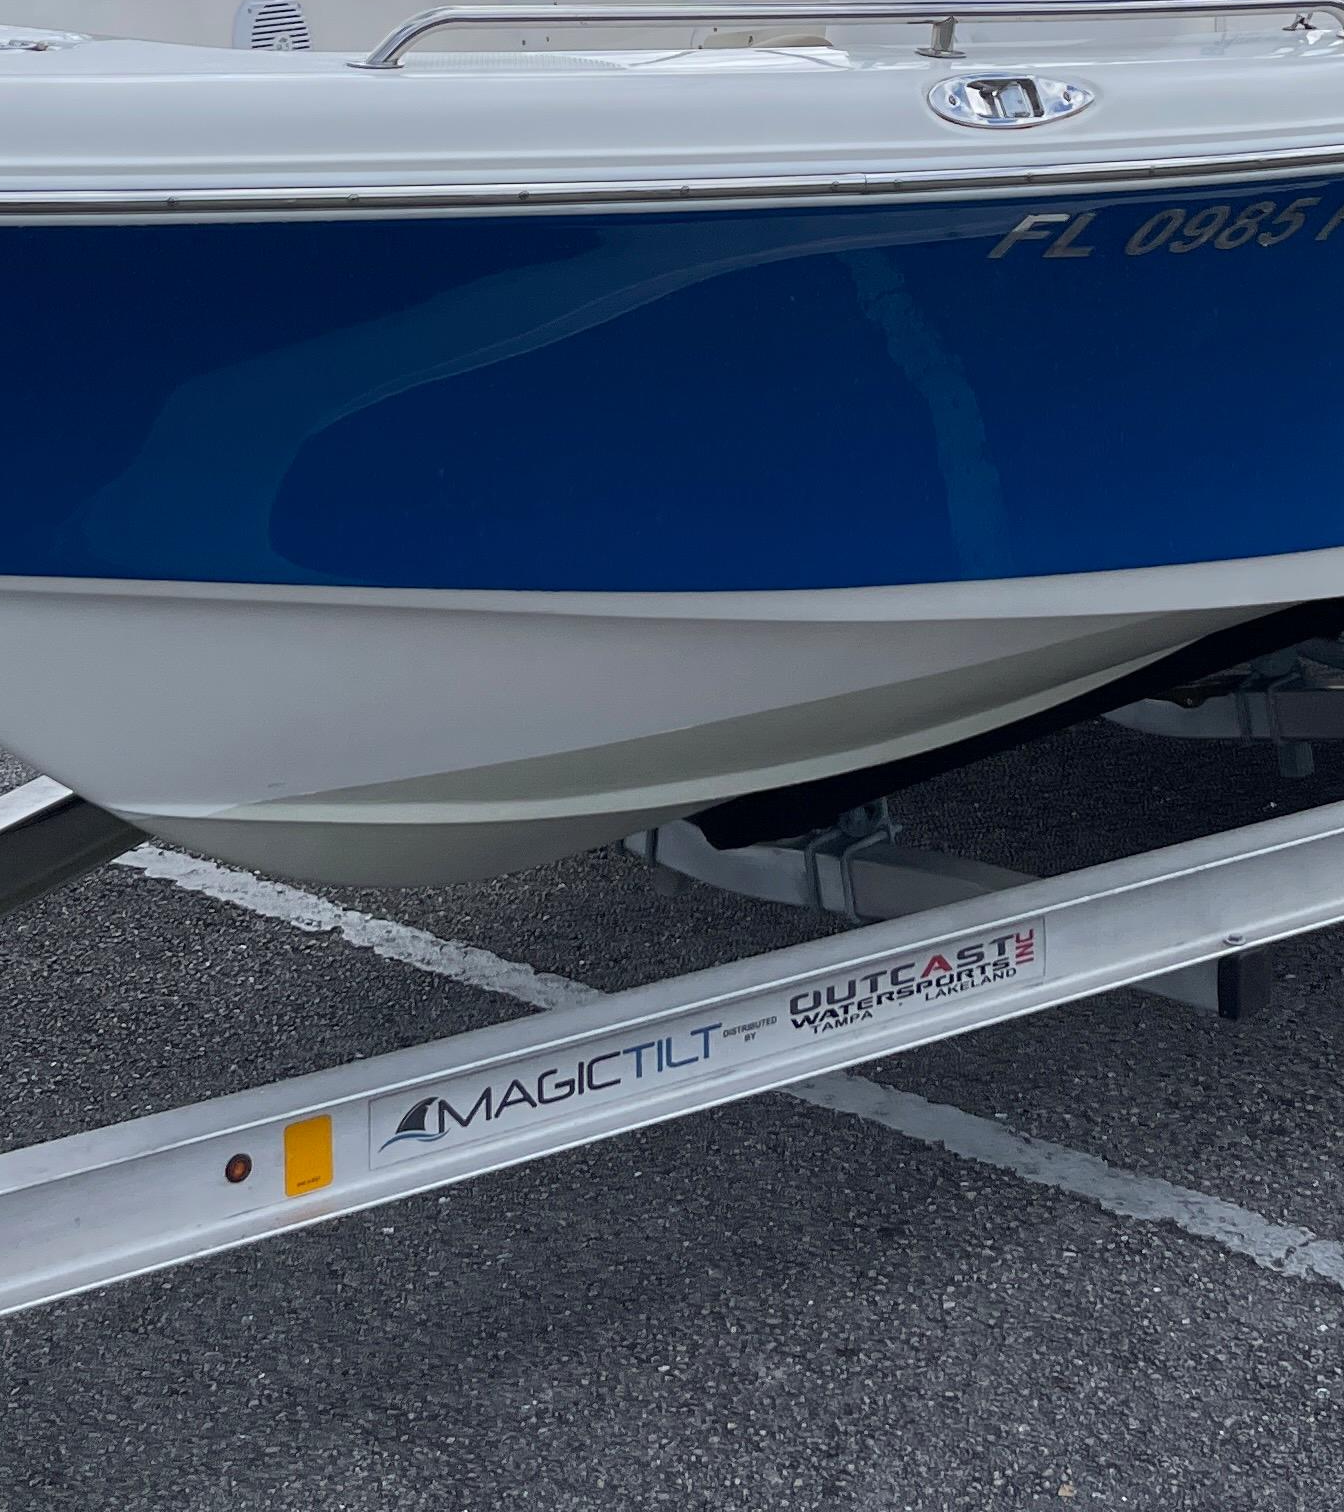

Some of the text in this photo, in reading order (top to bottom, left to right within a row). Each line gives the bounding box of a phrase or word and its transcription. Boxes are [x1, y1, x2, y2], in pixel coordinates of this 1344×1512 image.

[985, 212, 1097, 259] FL
[1124, 196, 1319, 256] 0985
[789, 933, 1017, 1017] OUTCAST
[1015, 928, 1035, 966] INC
[722, 1015, 778, 1038] DISTRIBUTED
[790, 956, 1011, 1030] WATERSPORTS
[812, 966, 1018, 1035] TAMPA LAKELAND
[436, 1022, 723, 1134] MAGICTILT
